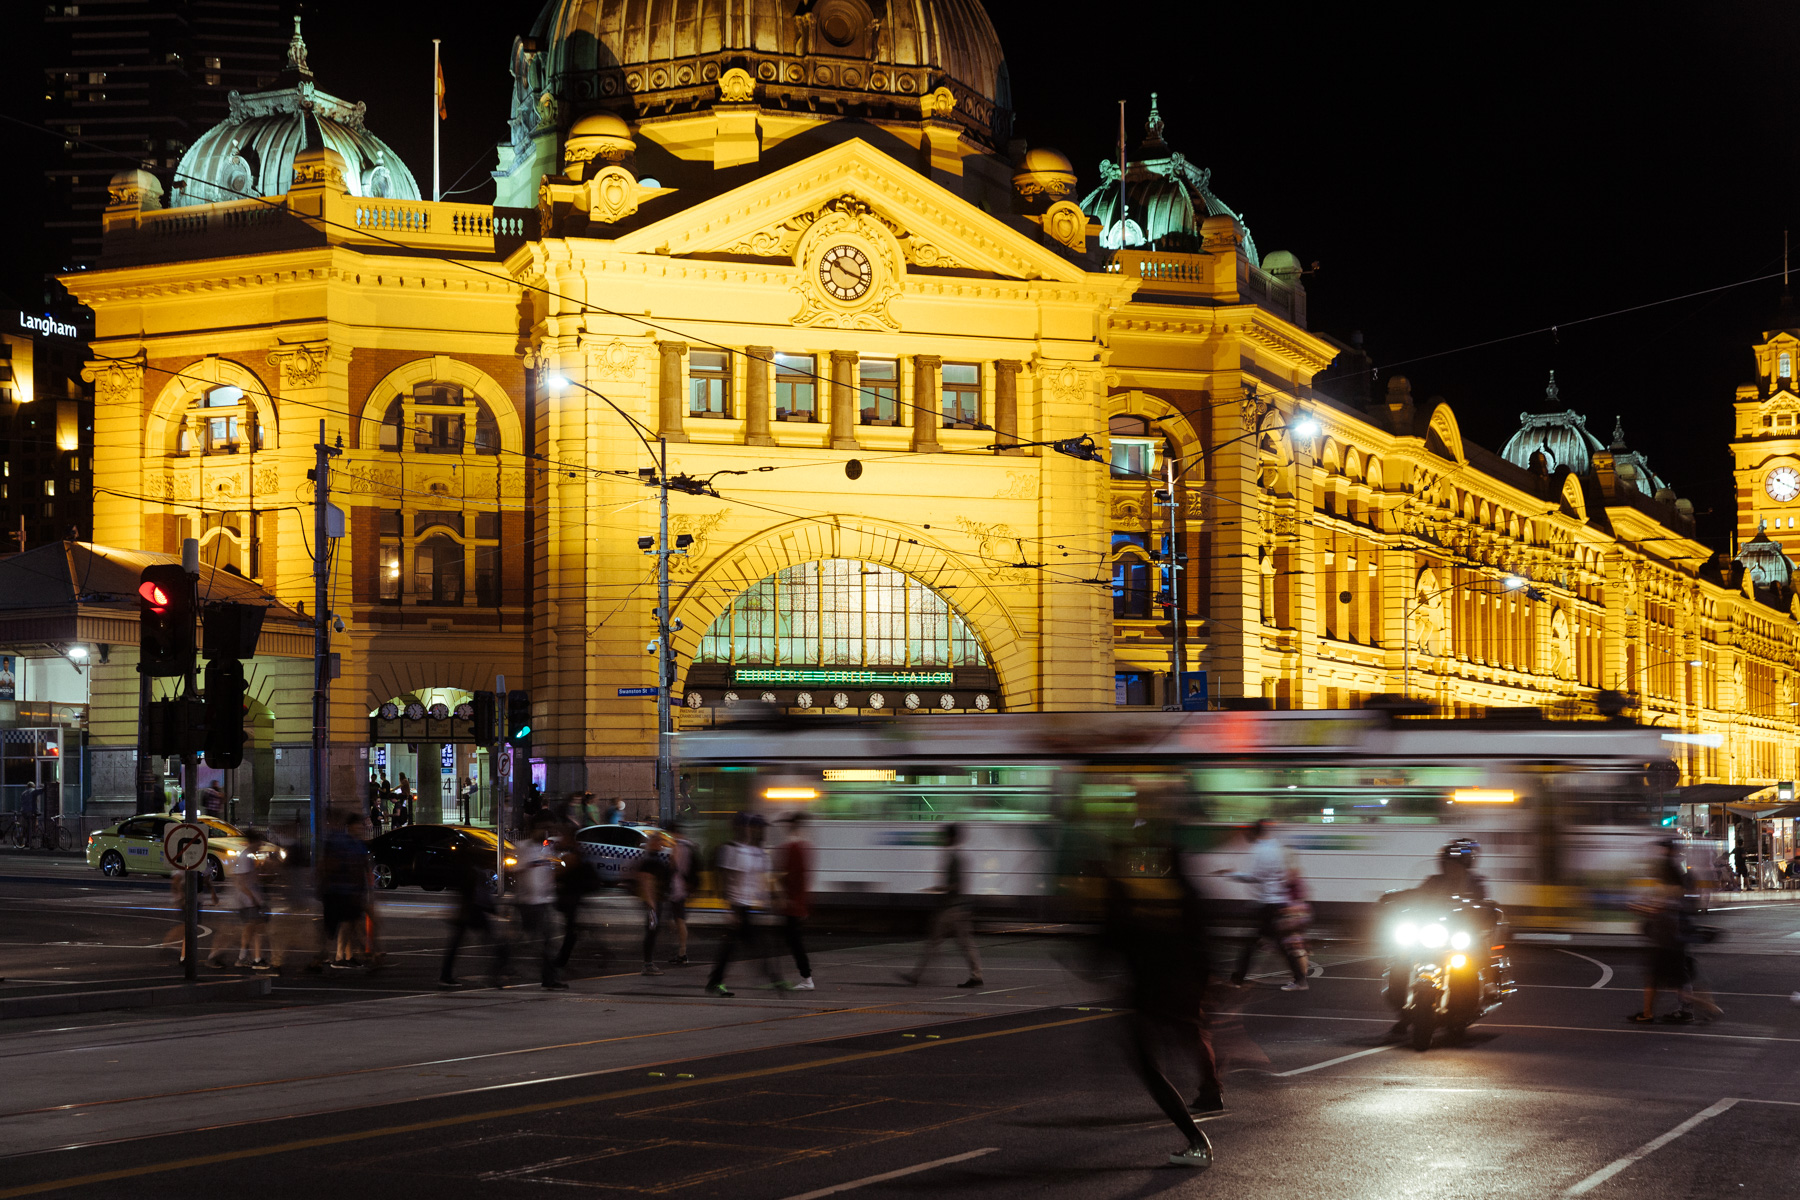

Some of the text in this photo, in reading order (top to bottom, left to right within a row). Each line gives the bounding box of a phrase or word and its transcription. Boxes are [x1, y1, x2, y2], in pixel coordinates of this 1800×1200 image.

[20, 310, 77, 338] Langham
[736, 669, 954, 683] FLINDERS STREET STATION
